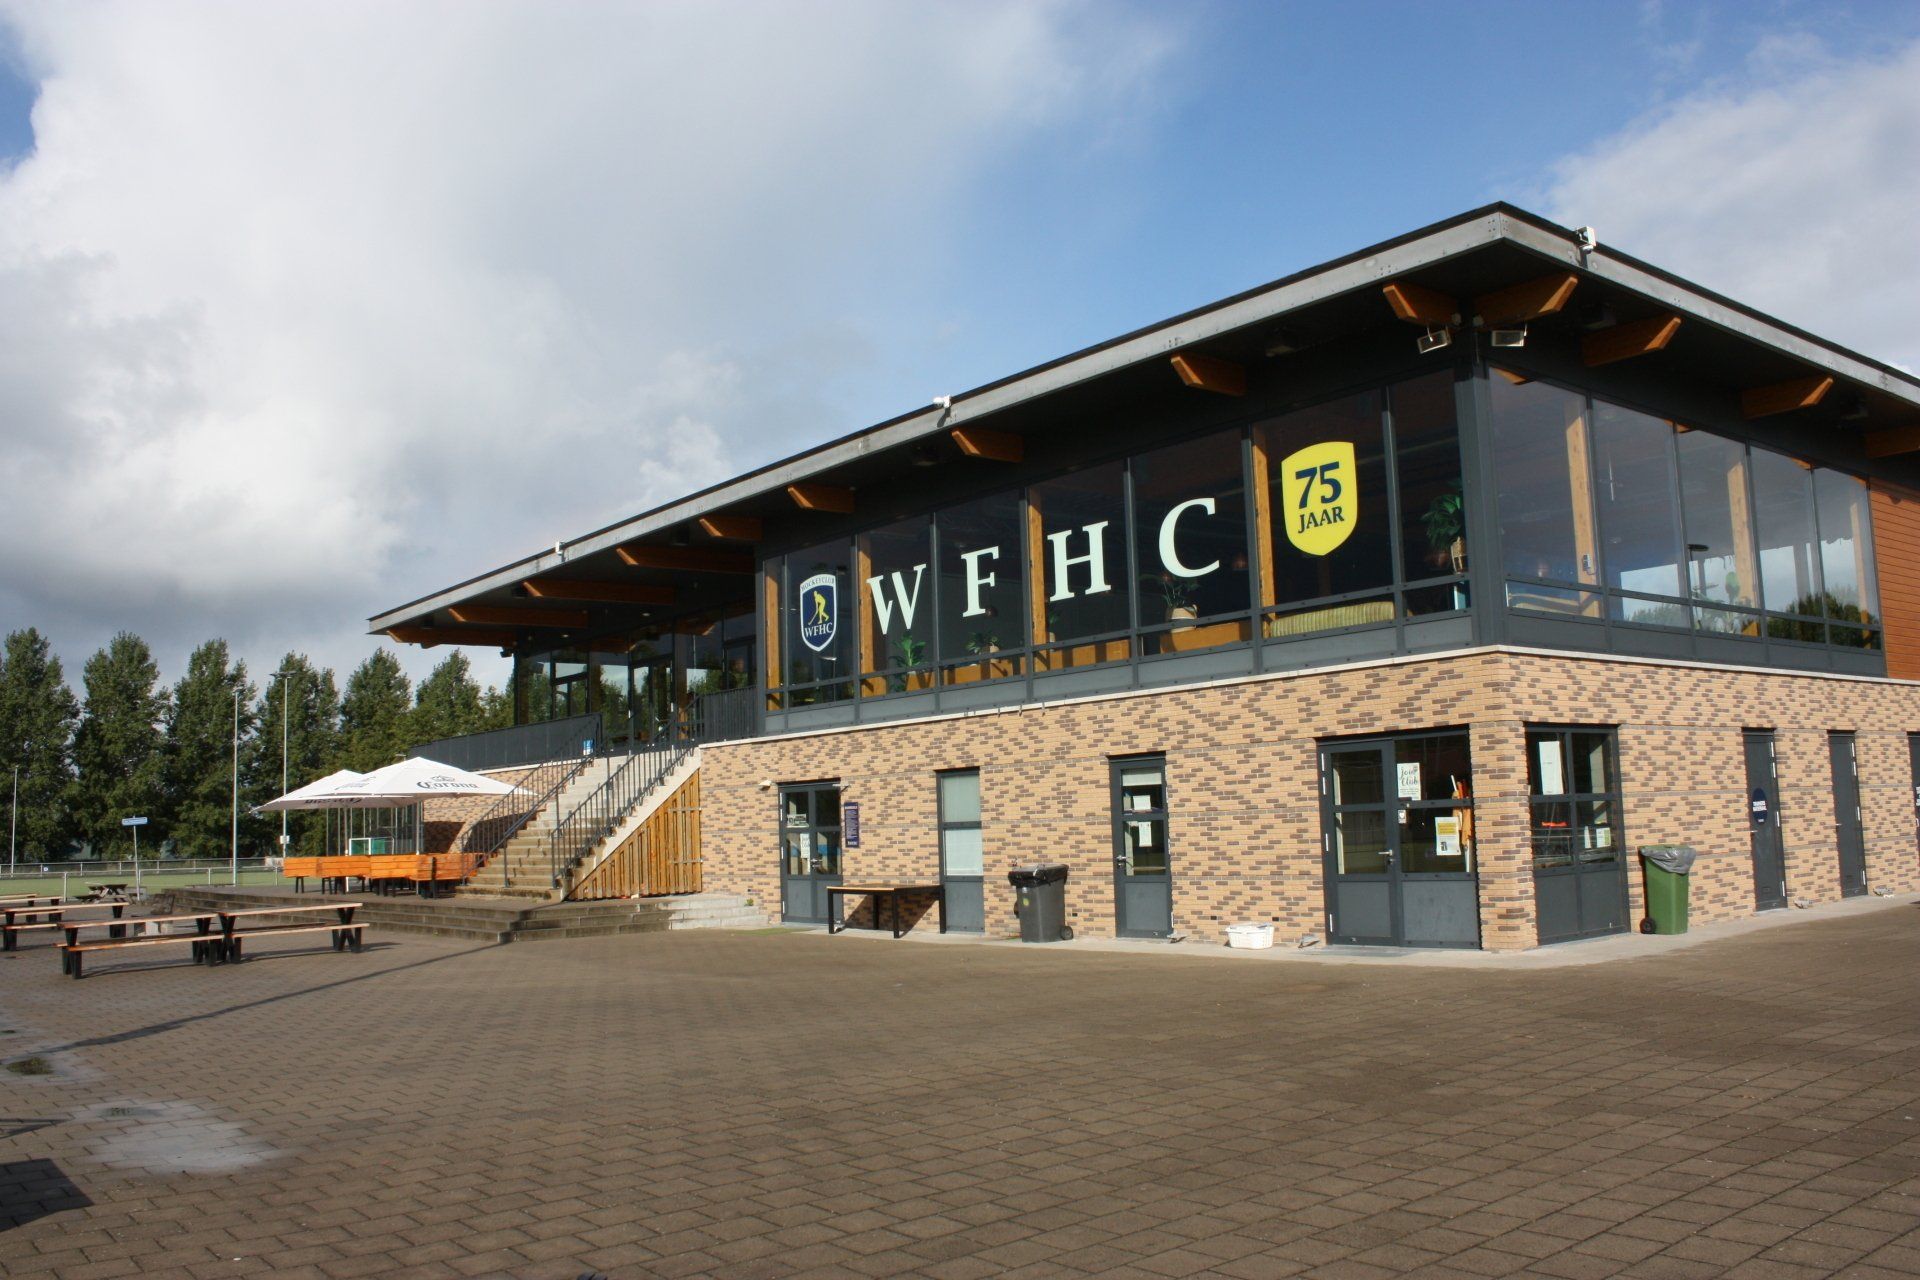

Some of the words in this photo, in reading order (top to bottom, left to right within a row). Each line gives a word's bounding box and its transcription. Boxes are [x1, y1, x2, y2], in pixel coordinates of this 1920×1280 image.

[1295, 461, 1342, 510] 75
[1297, 505, 1345, 534] JAAR
[804, 622, 833, 638] WFHC
[416, 781, 479, 790] Corona
